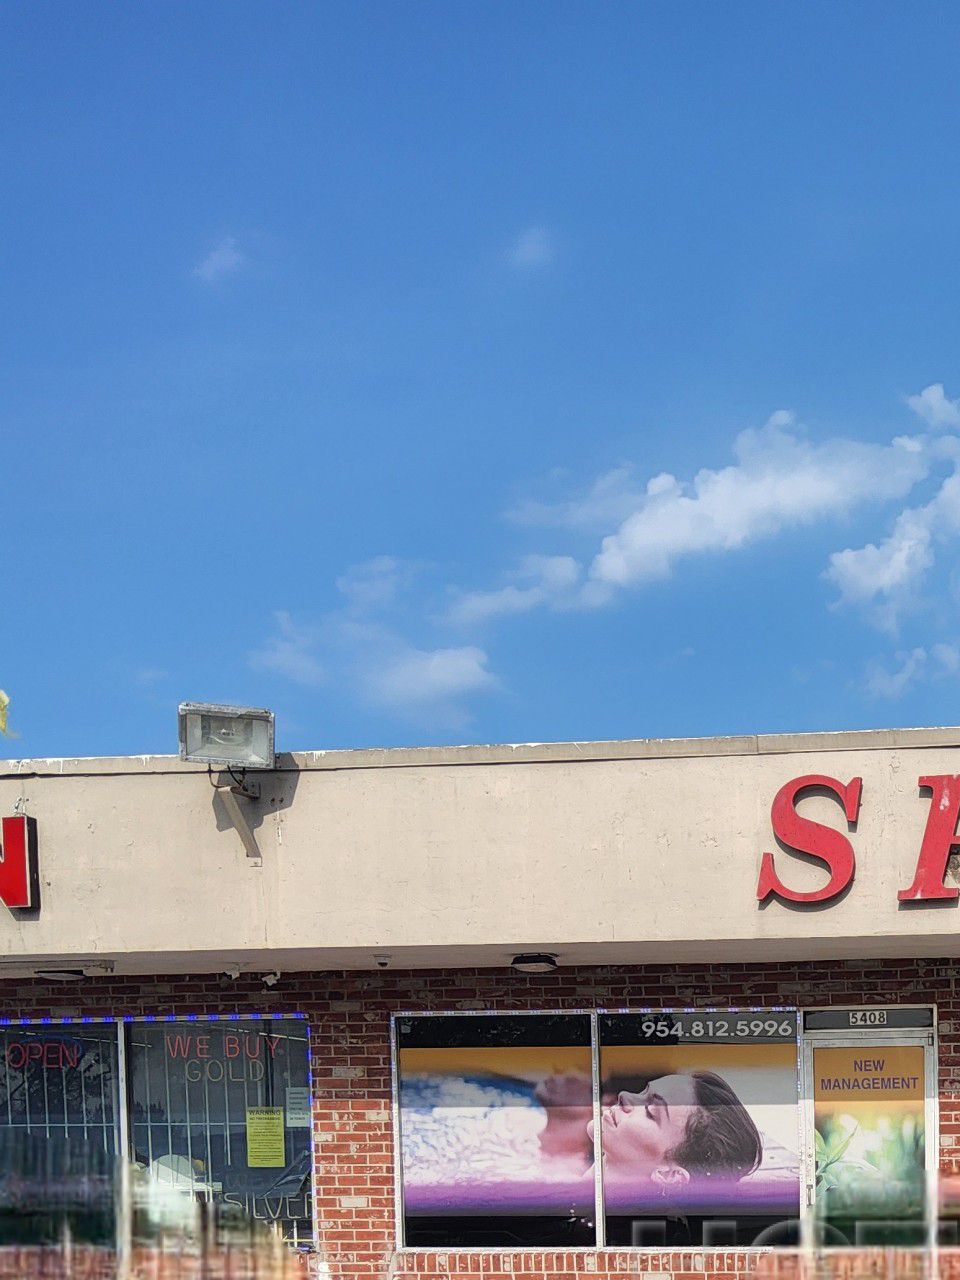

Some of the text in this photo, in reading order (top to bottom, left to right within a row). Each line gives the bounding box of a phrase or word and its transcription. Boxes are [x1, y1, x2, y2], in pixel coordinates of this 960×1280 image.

[850, 1011, 886, 1025] 5408
[641, 1020, 793, 1038] 954.812.5996
[7, 1043, 79, 1068] OPEN
[166, 1035, 281, 1058] WE BUY
[186, 1059, 264, 1081] GOLD
[853, 1060, 885, 1072] NEW
[820, 1077, 919, 1091] MANAGEMENT
